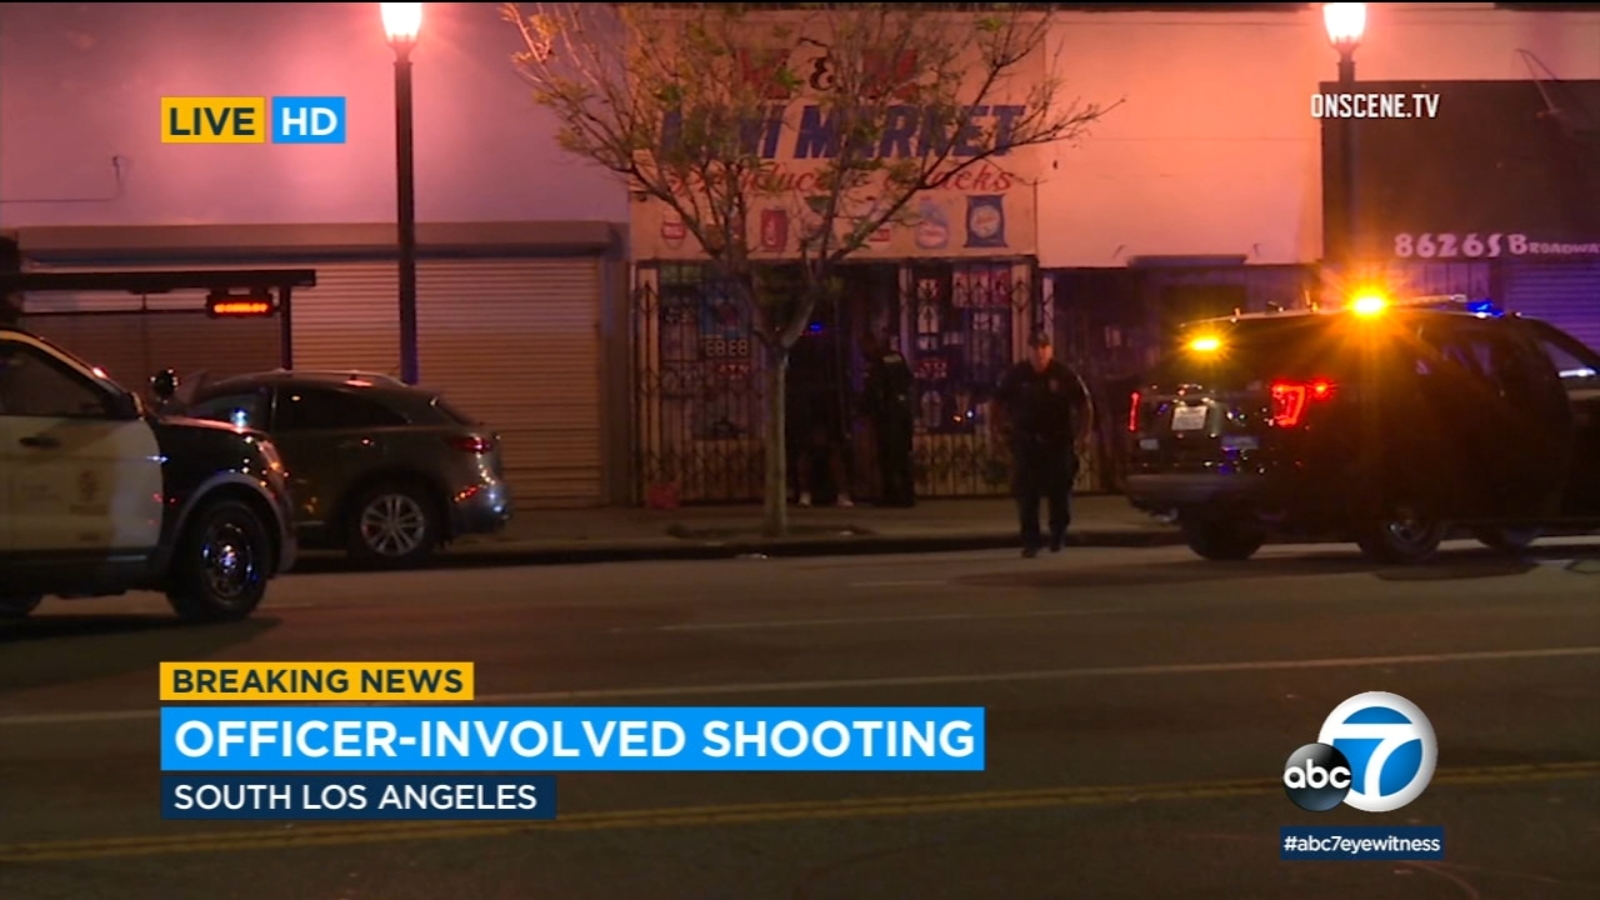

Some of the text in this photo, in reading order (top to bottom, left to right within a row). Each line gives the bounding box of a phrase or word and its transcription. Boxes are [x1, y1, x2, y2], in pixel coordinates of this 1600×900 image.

[656, 105, 786, 160] NI
[882, 162, 1014, 191] acks
[1508, 233, 1600, 255] BROADWA
